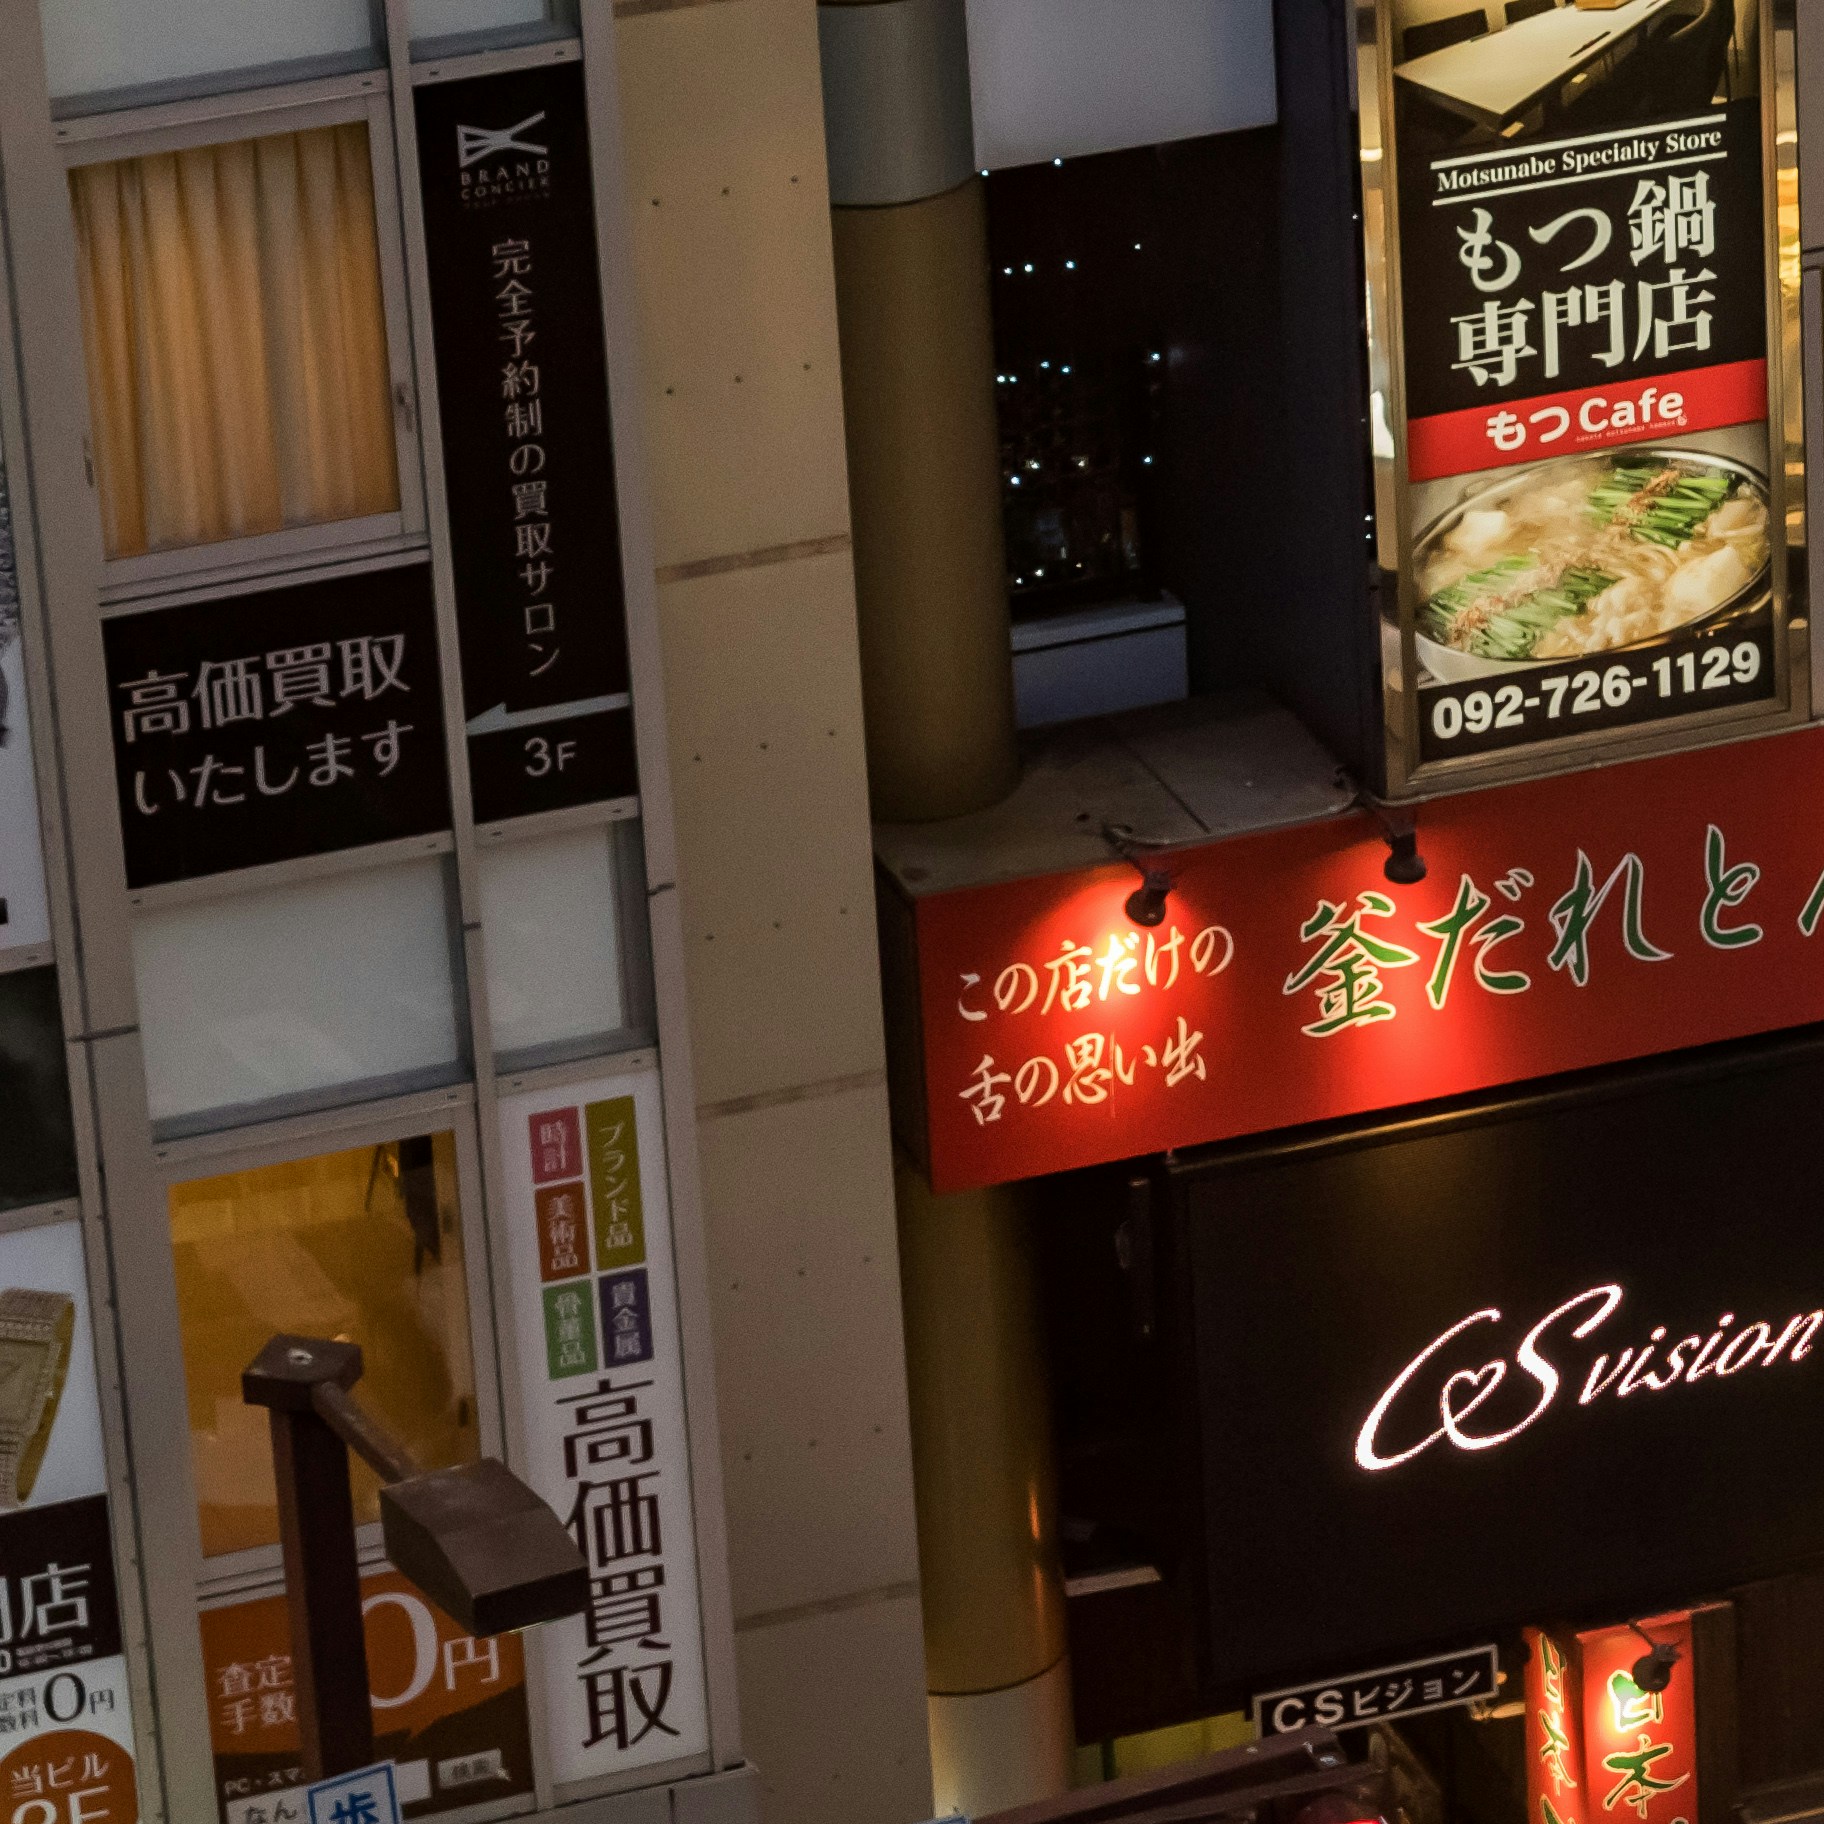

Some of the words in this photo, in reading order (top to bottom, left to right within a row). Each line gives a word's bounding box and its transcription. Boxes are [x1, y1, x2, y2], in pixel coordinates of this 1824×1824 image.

[461, 160, 549, 186] BRAND
[1437, 153, 1555, 193] Motsunabe
[1561, 136, 1660, 178] Specialty
[1665, 126, 1722, 154] Store
[1456, 170, 1716, 293] もつ鍋
[1450, 267, 1718, 387] 専門店
[492, 238, 560, 679] 完全予約制の買取サロン
[1486, 387, 1685, 451] もつCafe
[118, 633, 410, 743] 高価買取
[1431, 640, 1762, 741] 092-726-1129
[133, 719, 414, 816] いたします
[524, 737, 577, 776] 3F
[956, 923, 1236, 1025] この店だけの
[956, 1015, 1208, 1127] 舌の思い出
[0, 1562, 91, 1643] 店
[555, 1378, 681, 1752] 高価買取
[221, 1691, 297, 1735] 手数
[1271, 1666, 1485, 1736] CSビジョン
[11, 1752, 109, 1799] 当ビル
[224, 1767, 305, 1795] PC・スマ
